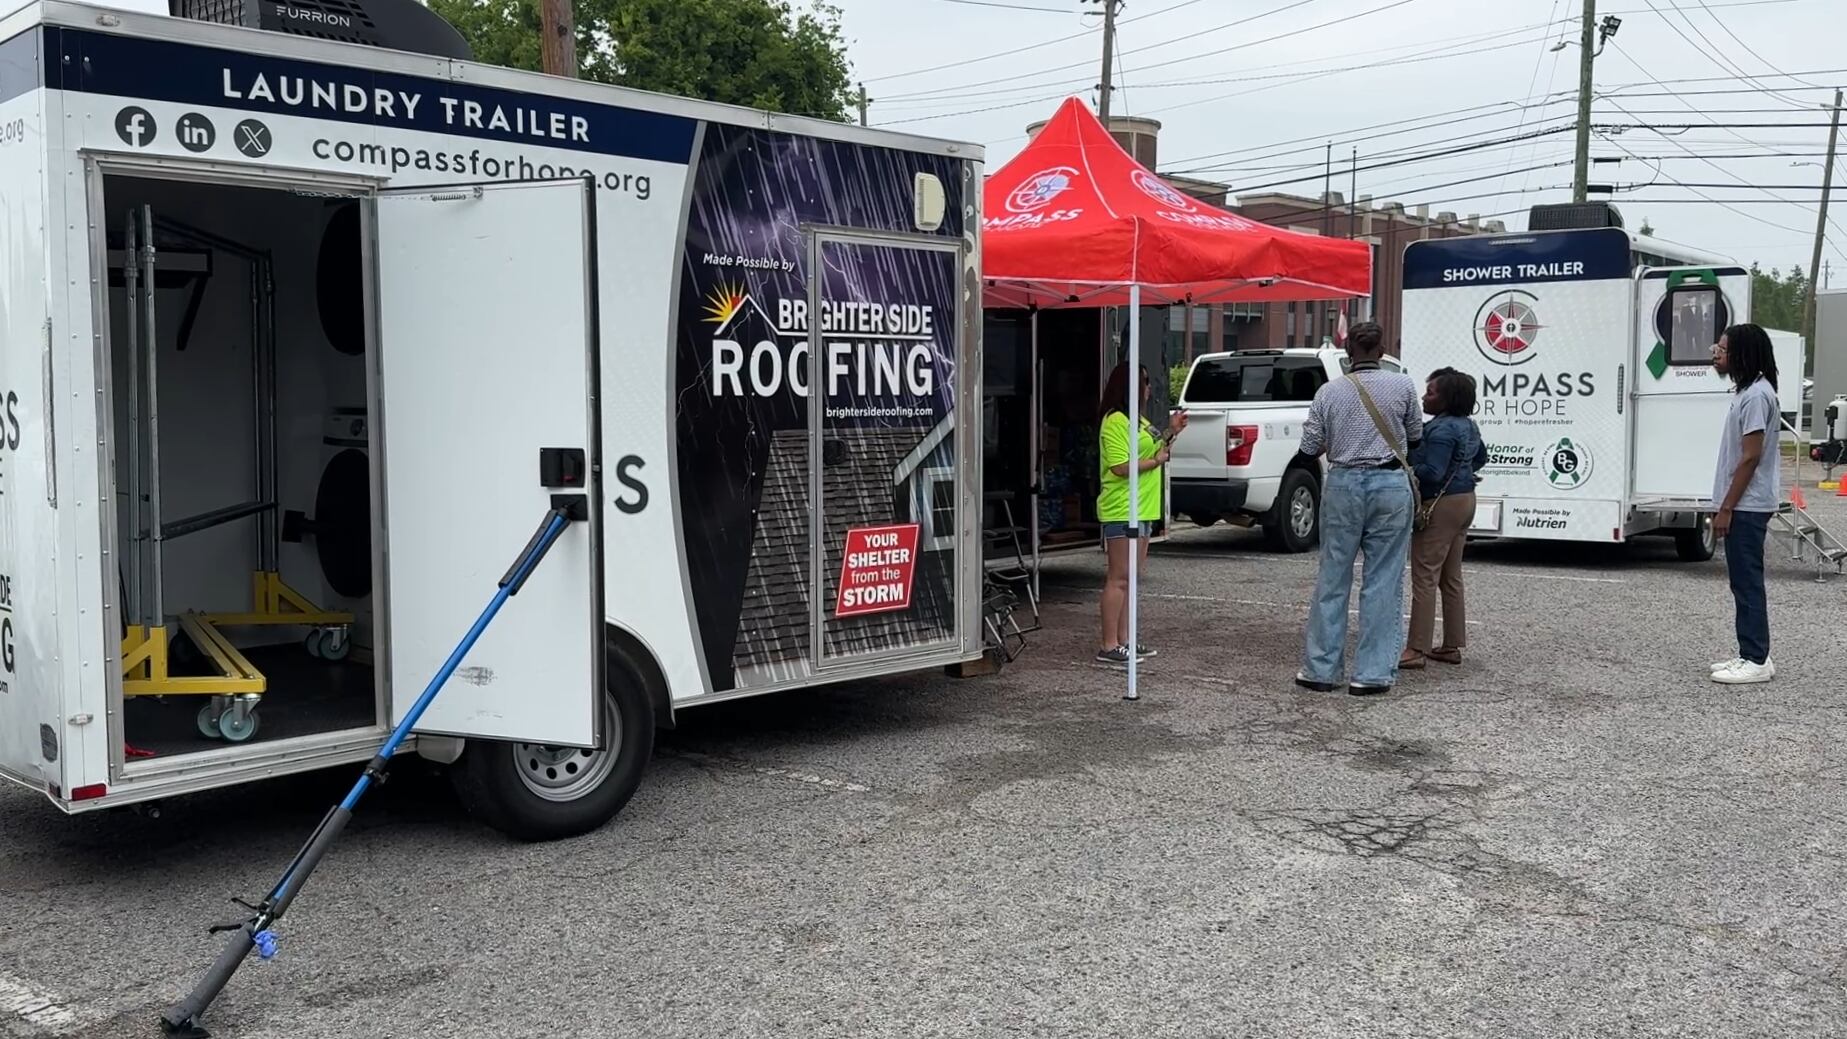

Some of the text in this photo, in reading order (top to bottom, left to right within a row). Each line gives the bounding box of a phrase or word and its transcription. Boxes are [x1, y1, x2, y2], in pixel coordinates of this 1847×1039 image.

[276, 5, 350, 27] FURRION
[223, 68, 590, 143] LAUNDRY TRAILER
[703, 253, 796, 272] Made Possible by
[1443, 261, 1584, 281] SHOWER TRAILER
[778, 298, 884, 333] BRGHTER
[712, 339, 933, 398] ROOFING
[1483, 372, 1595, 397] MPASS
[826, 405, 933, 419] brightersideroofing.com
[1505, 399, 1566, 416] HOPE
[1486, 443, 1525, 454] Honor
[614, 454, 649, 515] S
[1516, 516, 1567, 529] Nutrien
[864, 533, 898, 548] YOUR
[848, 548, 909, 569] SHELTER
[851, 567, 900, 584] from the
[843, 583, 904, 607] STORM
